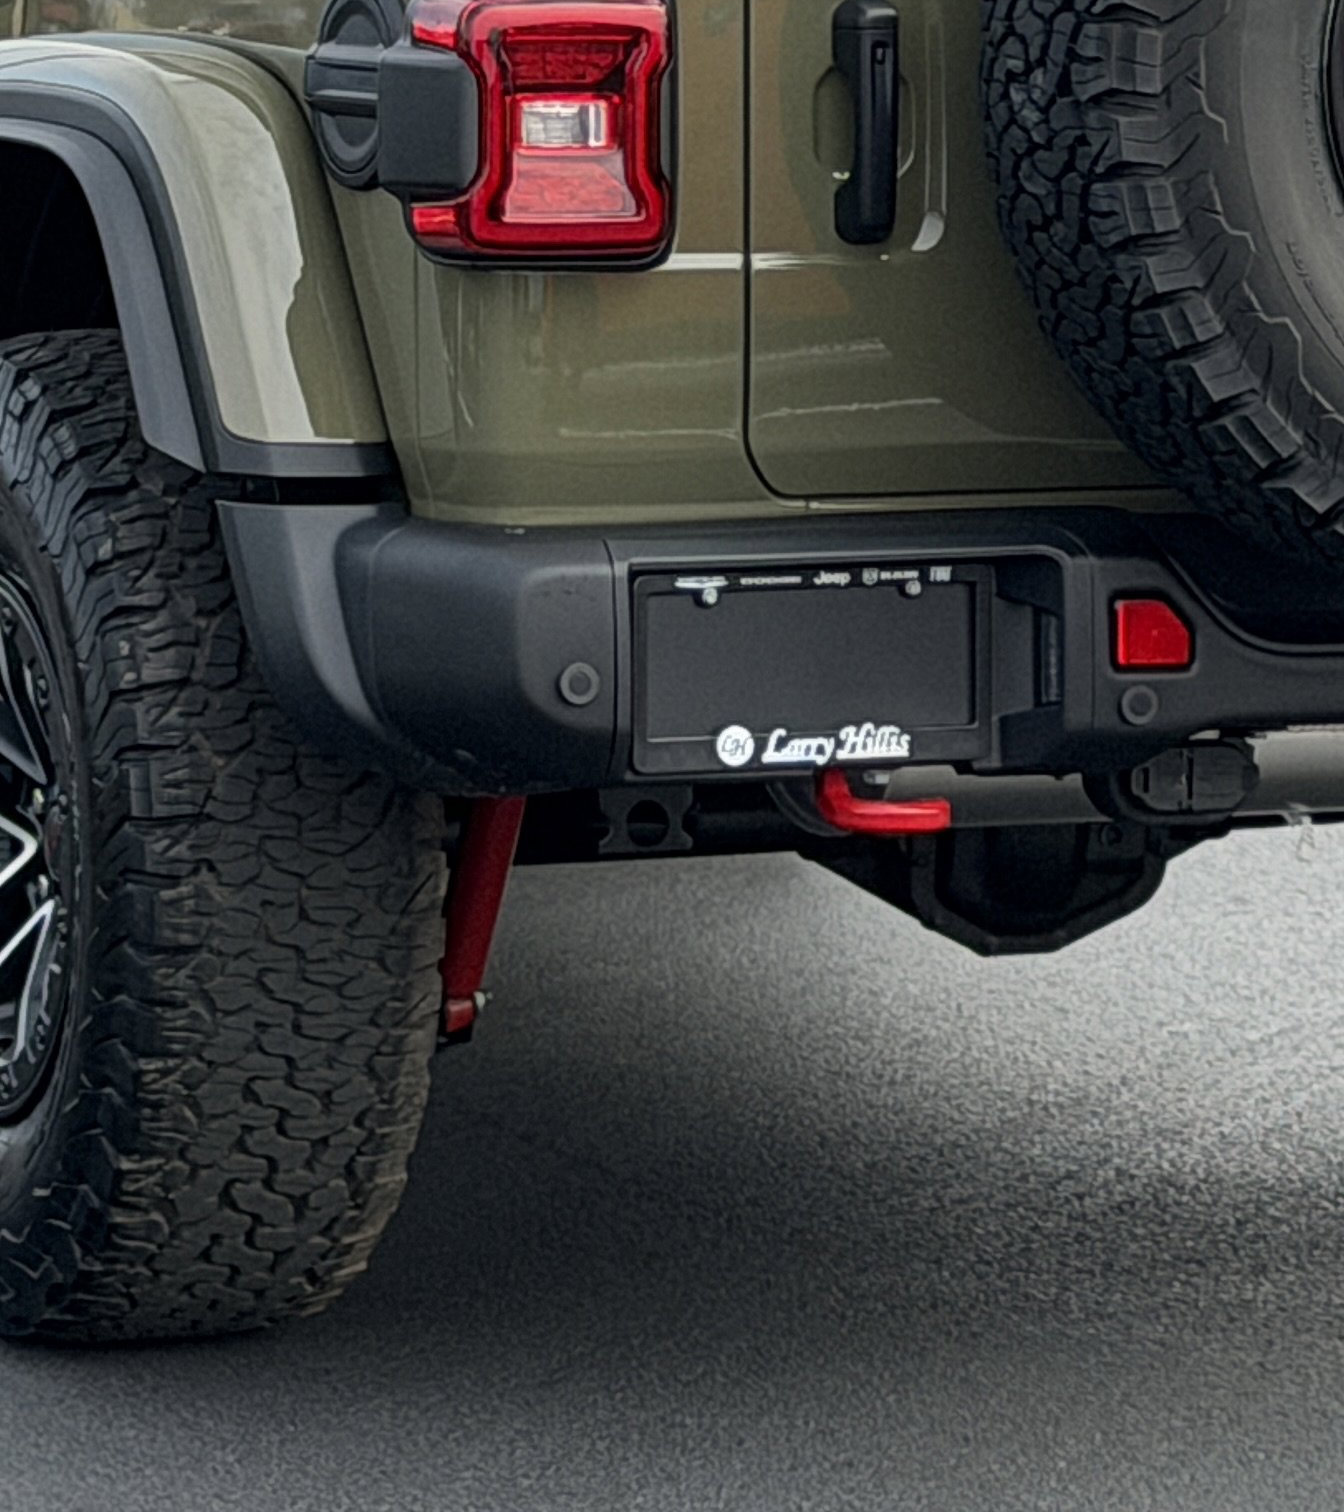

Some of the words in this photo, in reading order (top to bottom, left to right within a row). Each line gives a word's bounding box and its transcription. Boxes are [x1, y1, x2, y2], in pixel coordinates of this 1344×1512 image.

[813, 570, 851, 586] Jeep
[761, 728, 835, 766] Larry
[836, 722, 912, 761] Hillis
